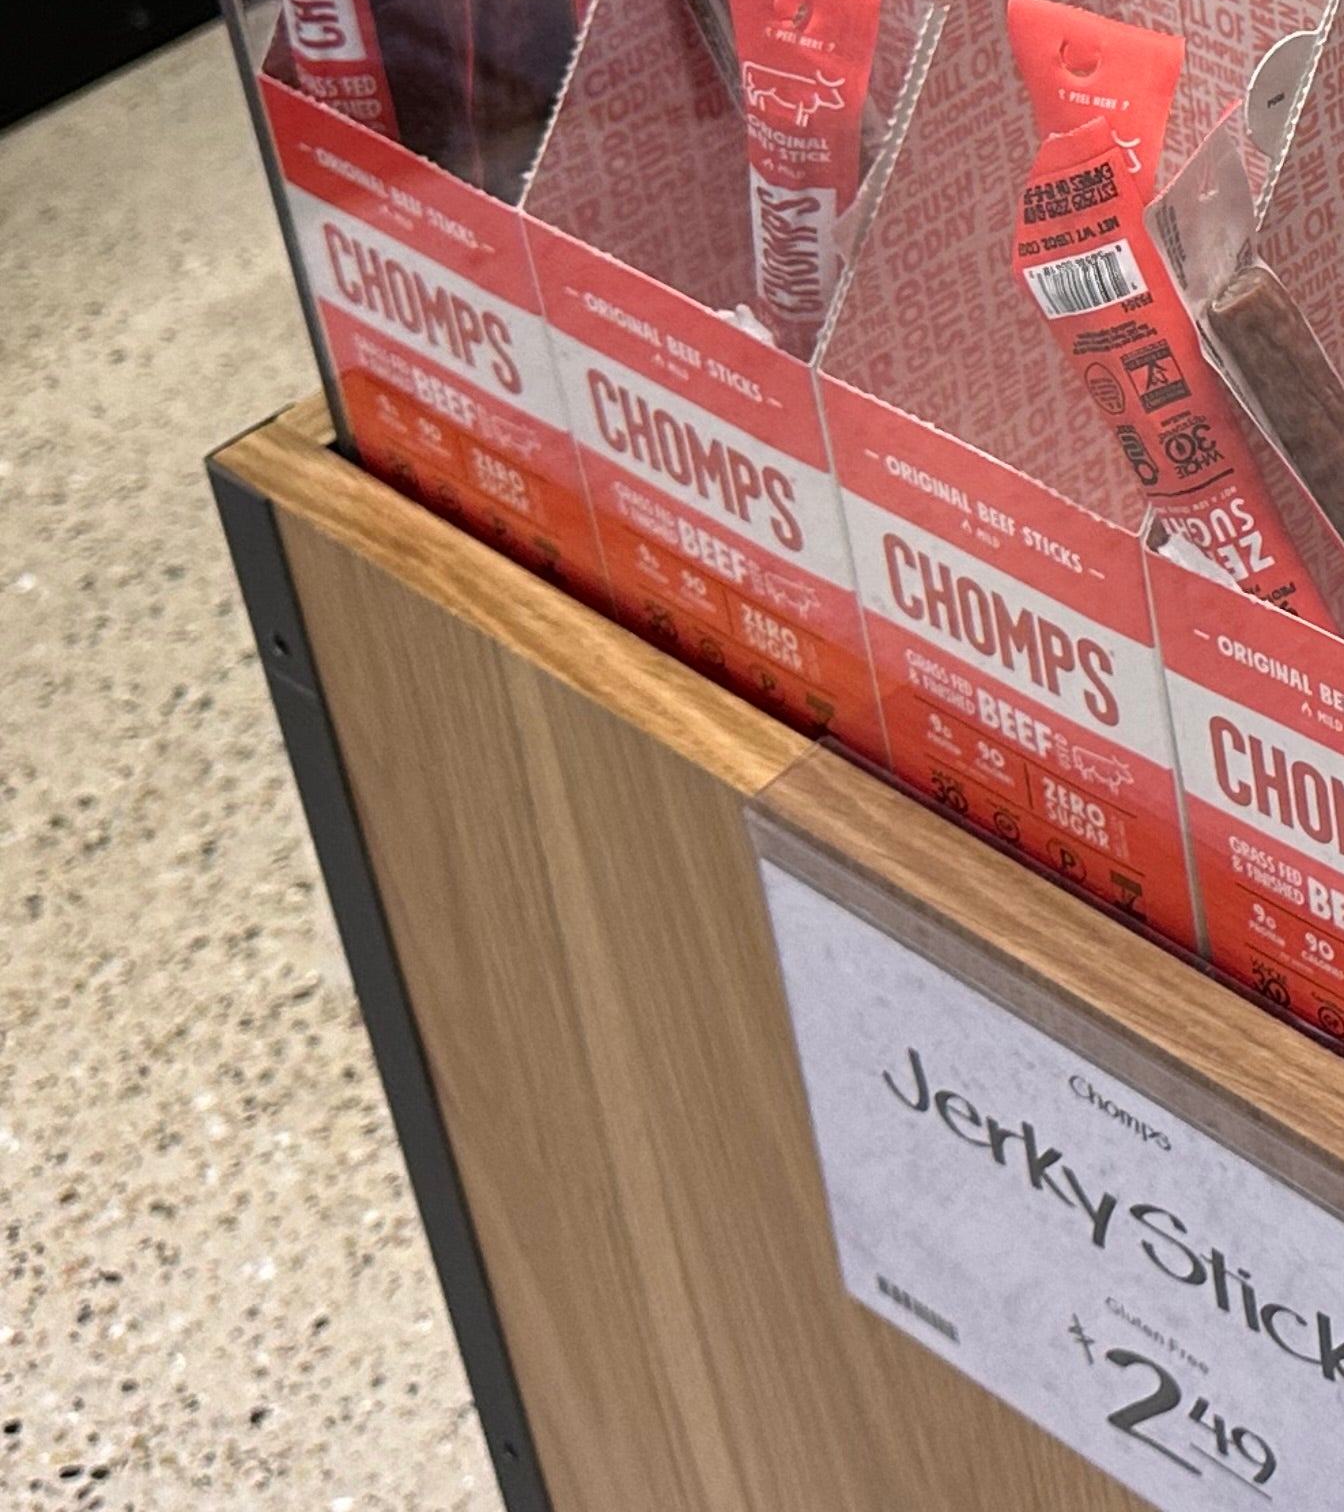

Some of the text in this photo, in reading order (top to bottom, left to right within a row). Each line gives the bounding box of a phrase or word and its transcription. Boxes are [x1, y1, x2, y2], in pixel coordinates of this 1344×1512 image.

[750, 114, 828, 150] ORIGINAL
[779, 144, 831, 163] STICK
[757, 186, 823, 316] CHOMPS
[324, 227, 523, 396] CHOMPS
[581, 289, 764, 404] ORIGINAL STICKS
[409, 365, 481, 434] BEEF
[589, 370, 803, 553] CHOMPS
[1177, 451, 1224, 480] WHOLE
[883, 451, 1083, 574] ORIGINAL BEEF STICKS
[675, 515, 752, 590] BEEF
[738, 600, 800, 654] ZERO
[883, 532, 1120, 729] CHOMPS
[1215, 632, 1313, 697] ORIGINAL
[975, 685, 1057, 764] BEEF
[1042, 776, 1106, 830] ZERO
[1045, 800, 1110, 851] SUGAR
[1226, 831, 1276, 874] GRASS
[882, 1048, 1117, 1248] Jerky
[1068, 1074, 1172, 1152] Chomps
[1105, 1295, 1210, 1377] Gluten Free
